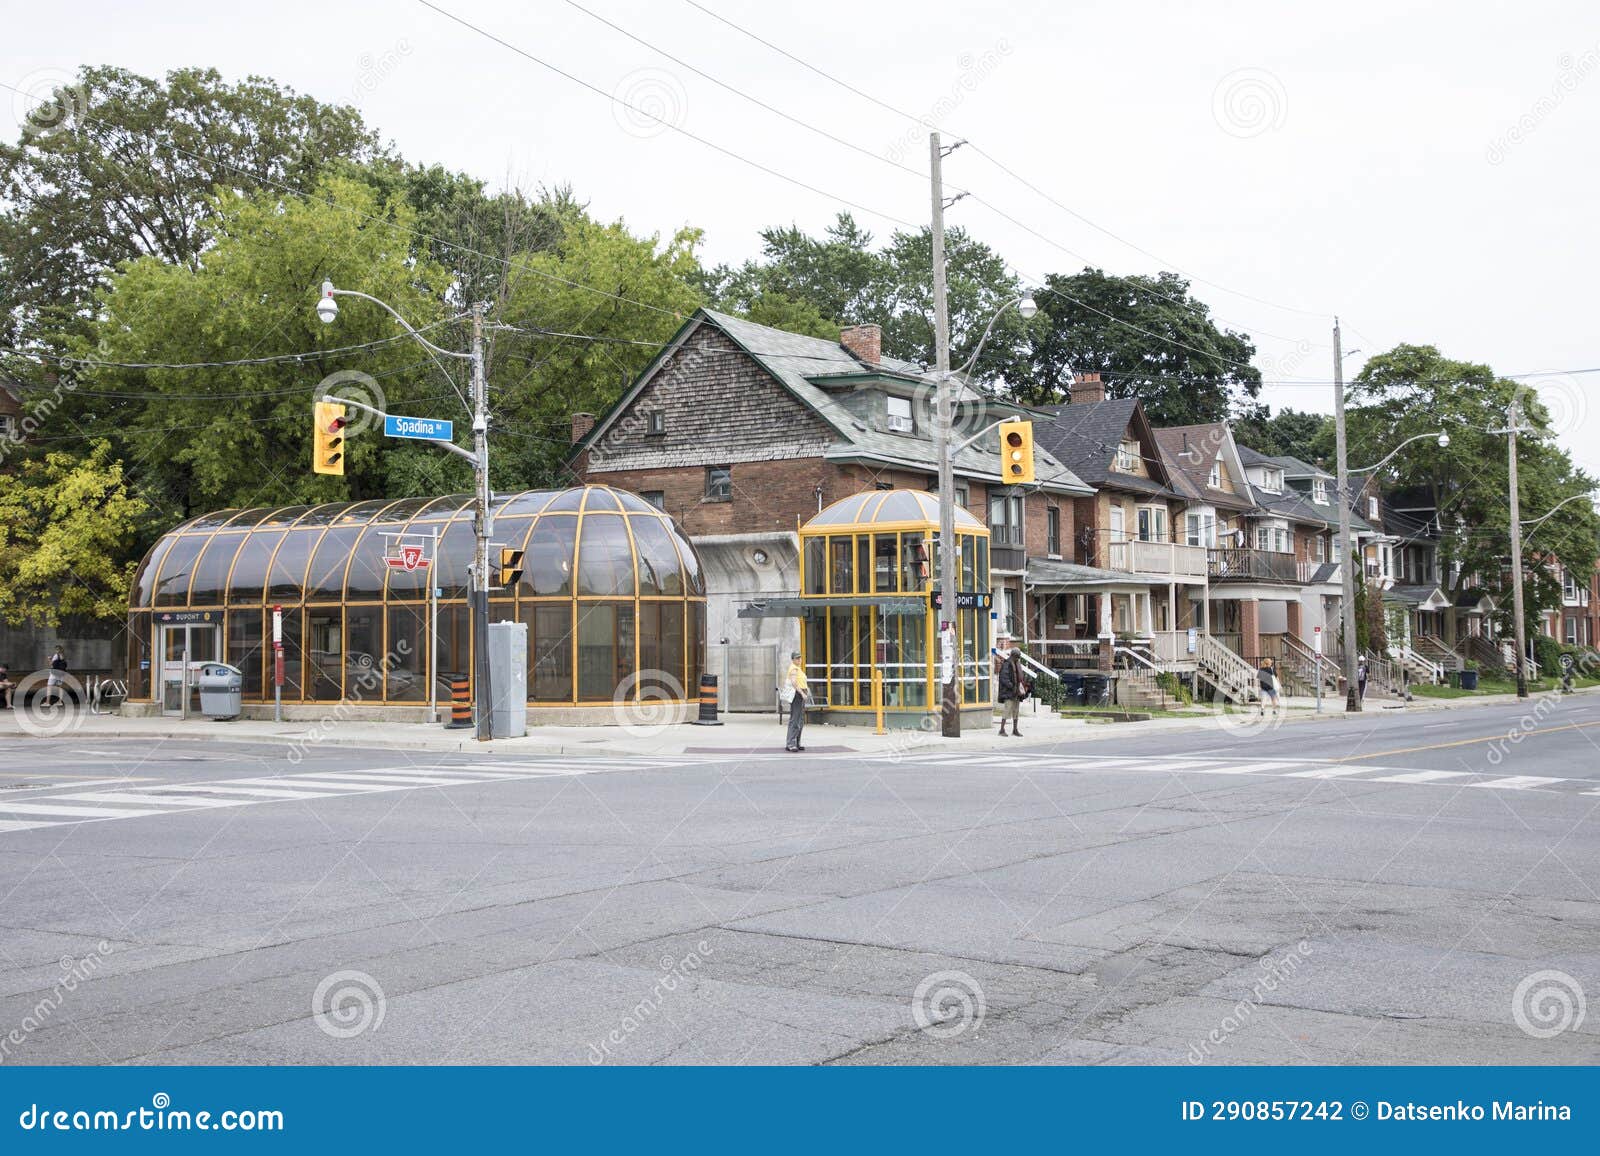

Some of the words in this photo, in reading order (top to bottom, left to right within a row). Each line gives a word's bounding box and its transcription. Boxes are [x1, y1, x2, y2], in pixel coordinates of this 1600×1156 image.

[396, 418, 434, 435] Spadina
[957, 596, 973, 605] PONT
[176, 613, 200, 621] DUPONT
